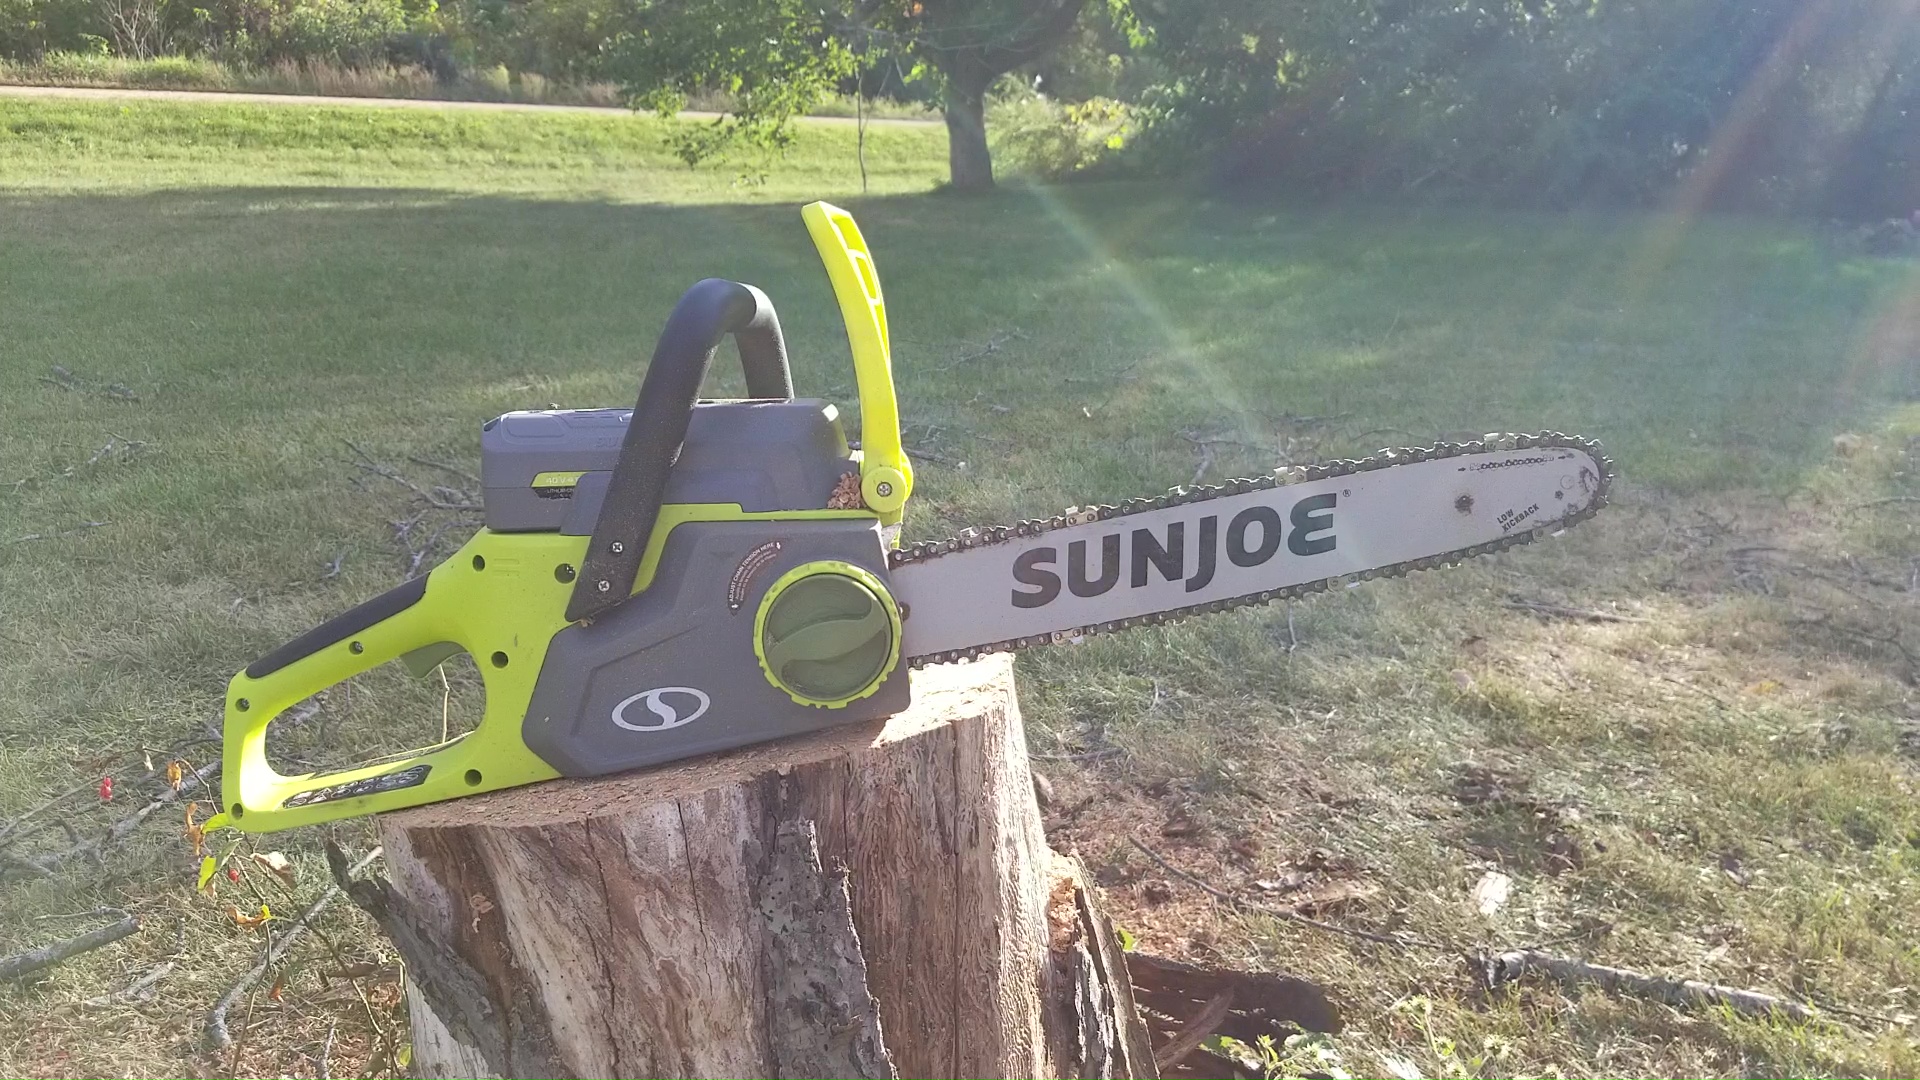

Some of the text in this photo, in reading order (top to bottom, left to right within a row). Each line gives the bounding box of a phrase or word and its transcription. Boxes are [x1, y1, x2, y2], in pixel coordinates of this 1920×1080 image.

[1497, 508, 1514, 524] LOW
[1501, 503, 1540, 532] KICKBACK
[728, 581, 737, 602] ADJUST
[733, 566, 745, 582] CHAIN
[760, 542, 775, 552] HERE
[1011, 492, 1337, 609] SUNJOE
